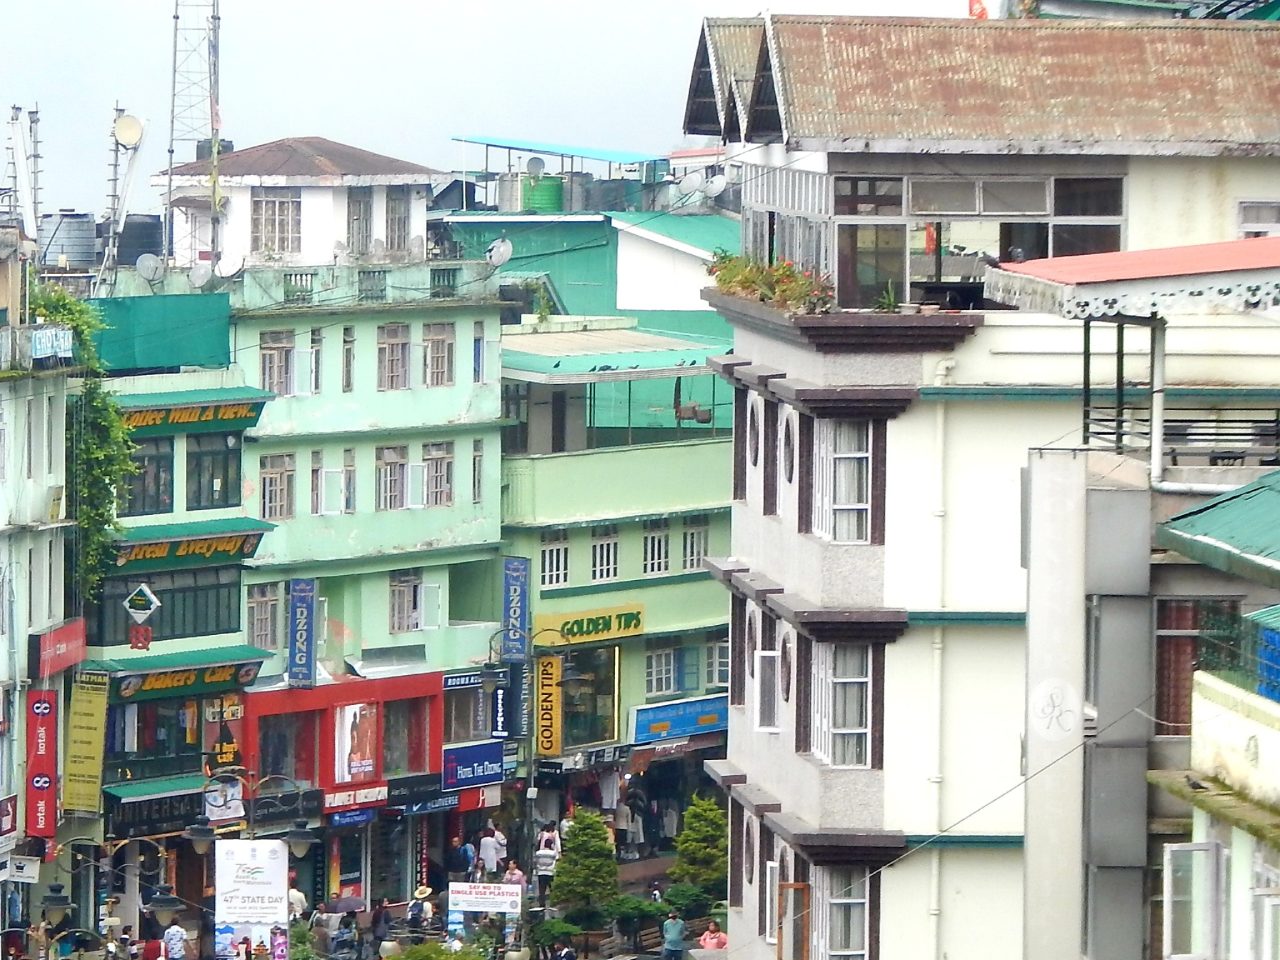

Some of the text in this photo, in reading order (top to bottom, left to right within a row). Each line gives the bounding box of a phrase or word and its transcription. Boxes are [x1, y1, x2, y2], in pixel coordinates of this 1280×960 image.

[509, 586, 520, 639] DZONG
[561, 610, 642, 638] GOLDEN TIPS
[295, 607, 308, 664] DZONG
[540, 661, 553, 751] GOLDEN TIPS
[36, 726, 47, 755] kotak
[457, 765, 473, 779] HOTEL
[474, 762, 483, 776] THE
[36, 800, 46, 829] kotak
[241, 896, 265, 904] STATE
[267, 896, 284, 904] DAY
